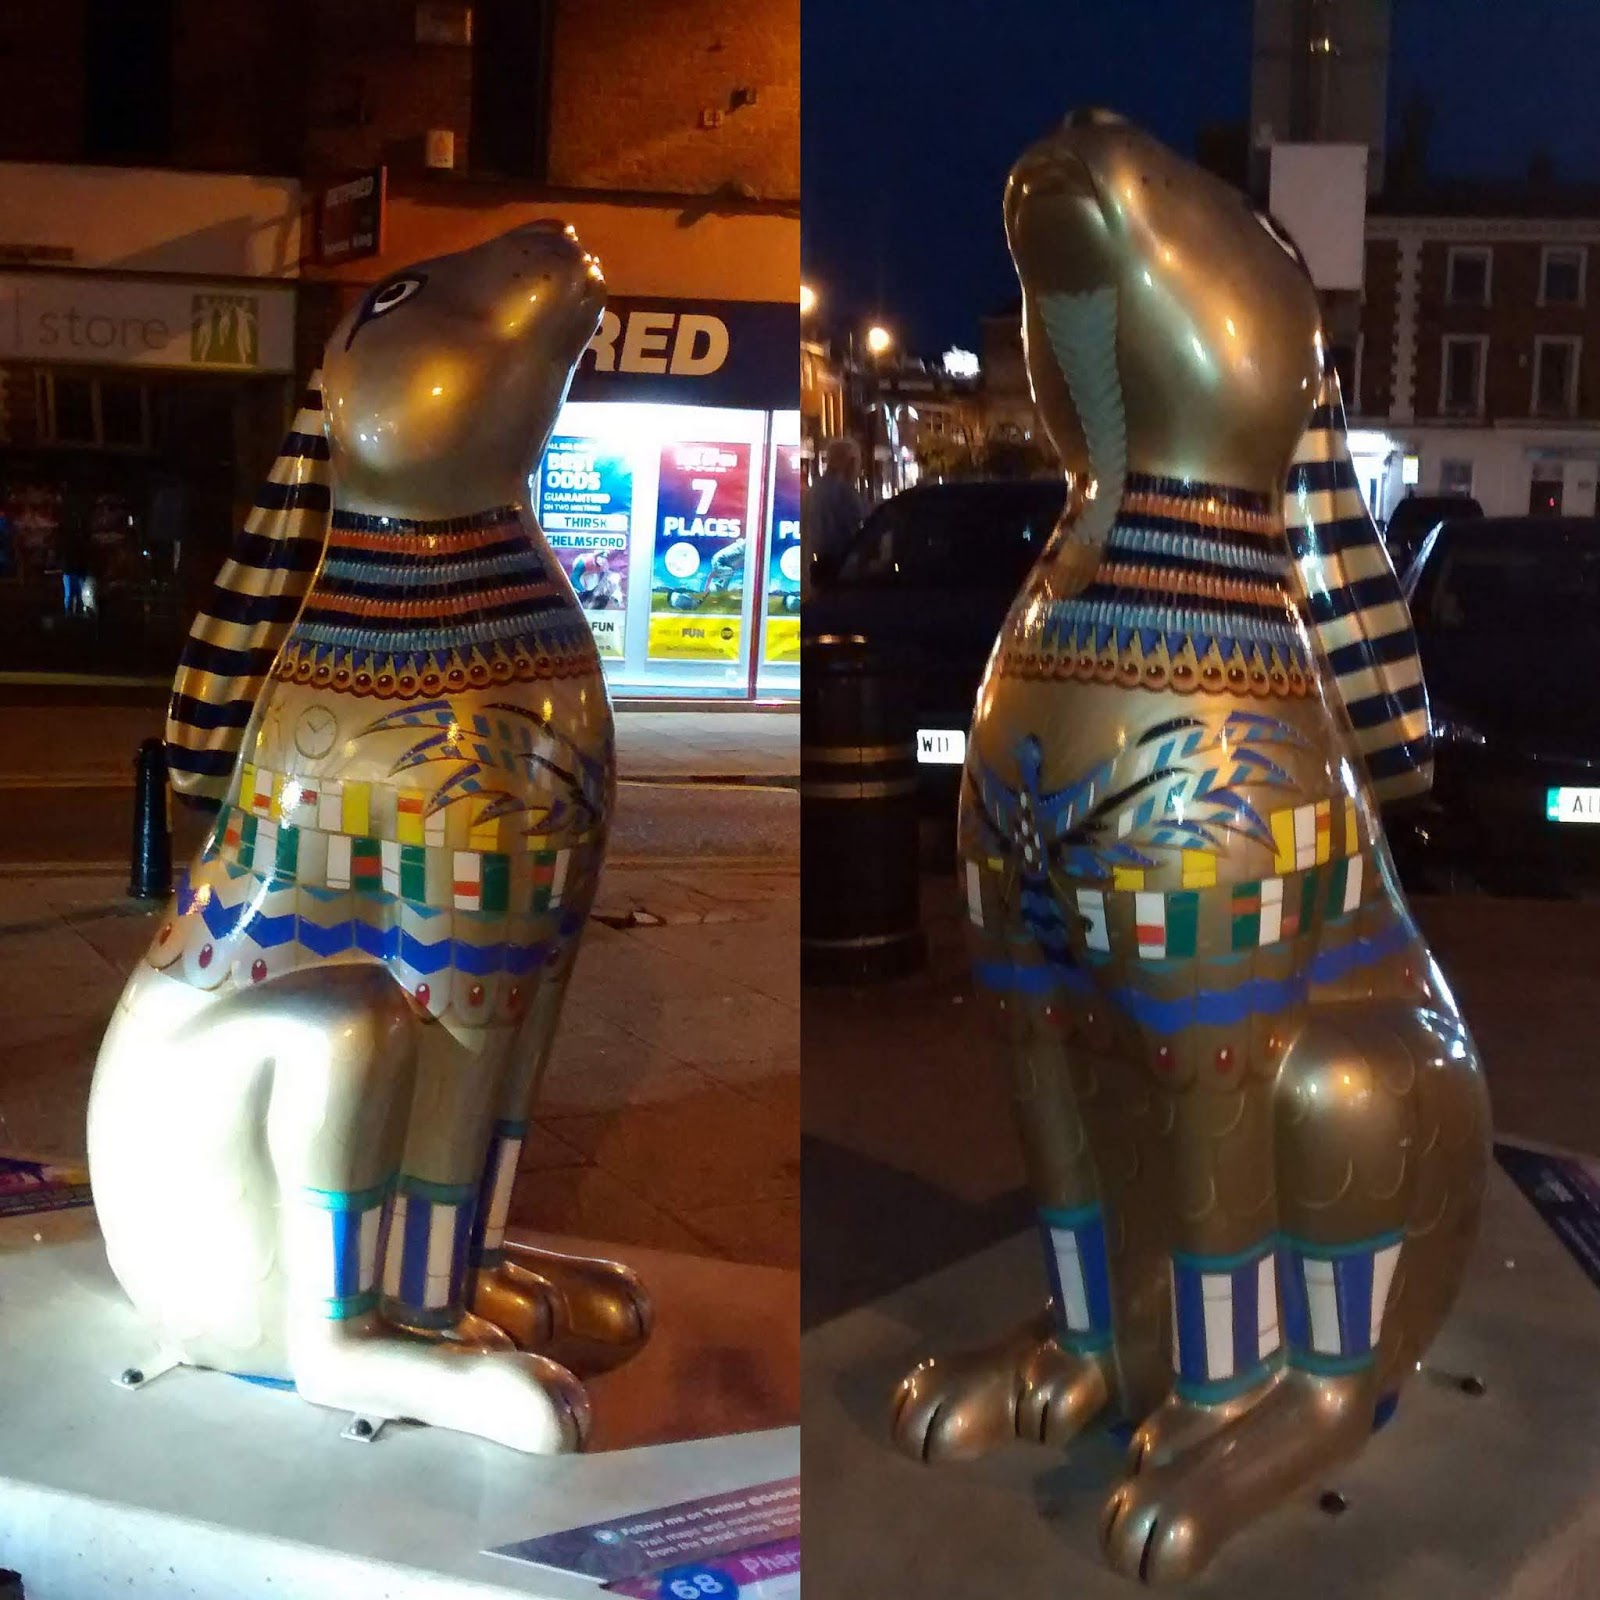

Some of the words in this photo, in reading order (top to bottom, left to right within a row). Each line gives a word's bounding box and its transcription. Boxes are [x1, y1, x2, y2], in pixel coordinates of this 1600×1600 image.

[39, 306, 169, 350] store
[577, 310, 730, 376] RED
[546, 471, 601, 491] ODDS
[692, 478, 718, 515] 7
[564, 516, 607, 529] THIRSK
[663, 516, 741, 538] PLACES
[591, 621, 614, 632] FUN
[682, 627, 705, 638] FUN
[621, 1522, 664, 1536] Follow
[703, 1501, 746, 1516] Twitter
[646, 1547, 678, 1558] from
[678, 1541, 701, 1550] the
[670, 1573, 723, 1600] 68
